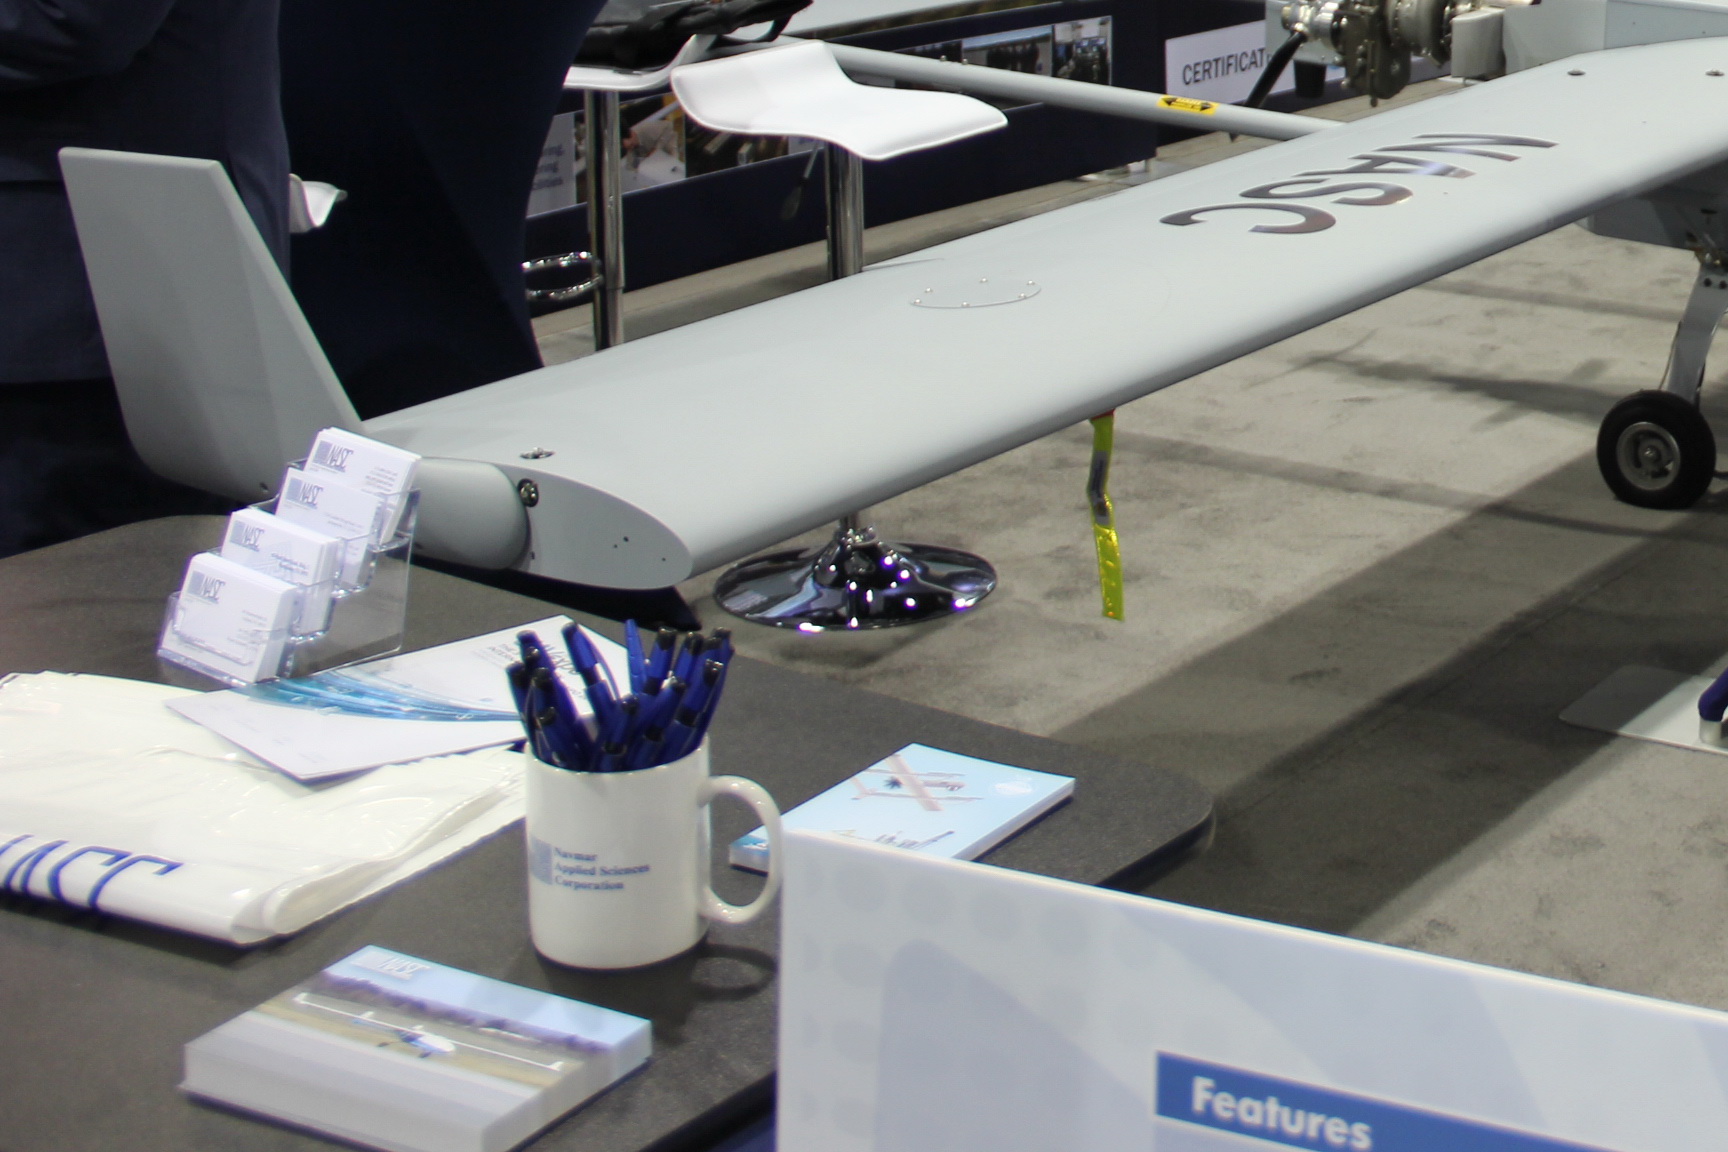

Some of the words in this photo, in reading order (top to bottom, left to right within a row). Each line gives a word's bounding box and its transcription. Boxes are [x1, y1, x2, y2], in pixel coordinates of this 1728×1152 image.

[1159, 133, 1560, 234] NASC
[555, 847, 598, 862] Navmar
[556, 862, 597, 876] Applied
[600, 864, 652, 876] Sciences
[555, 875, 624, 890] Corporation
[1191, 1075, 1373, 1152] Features
